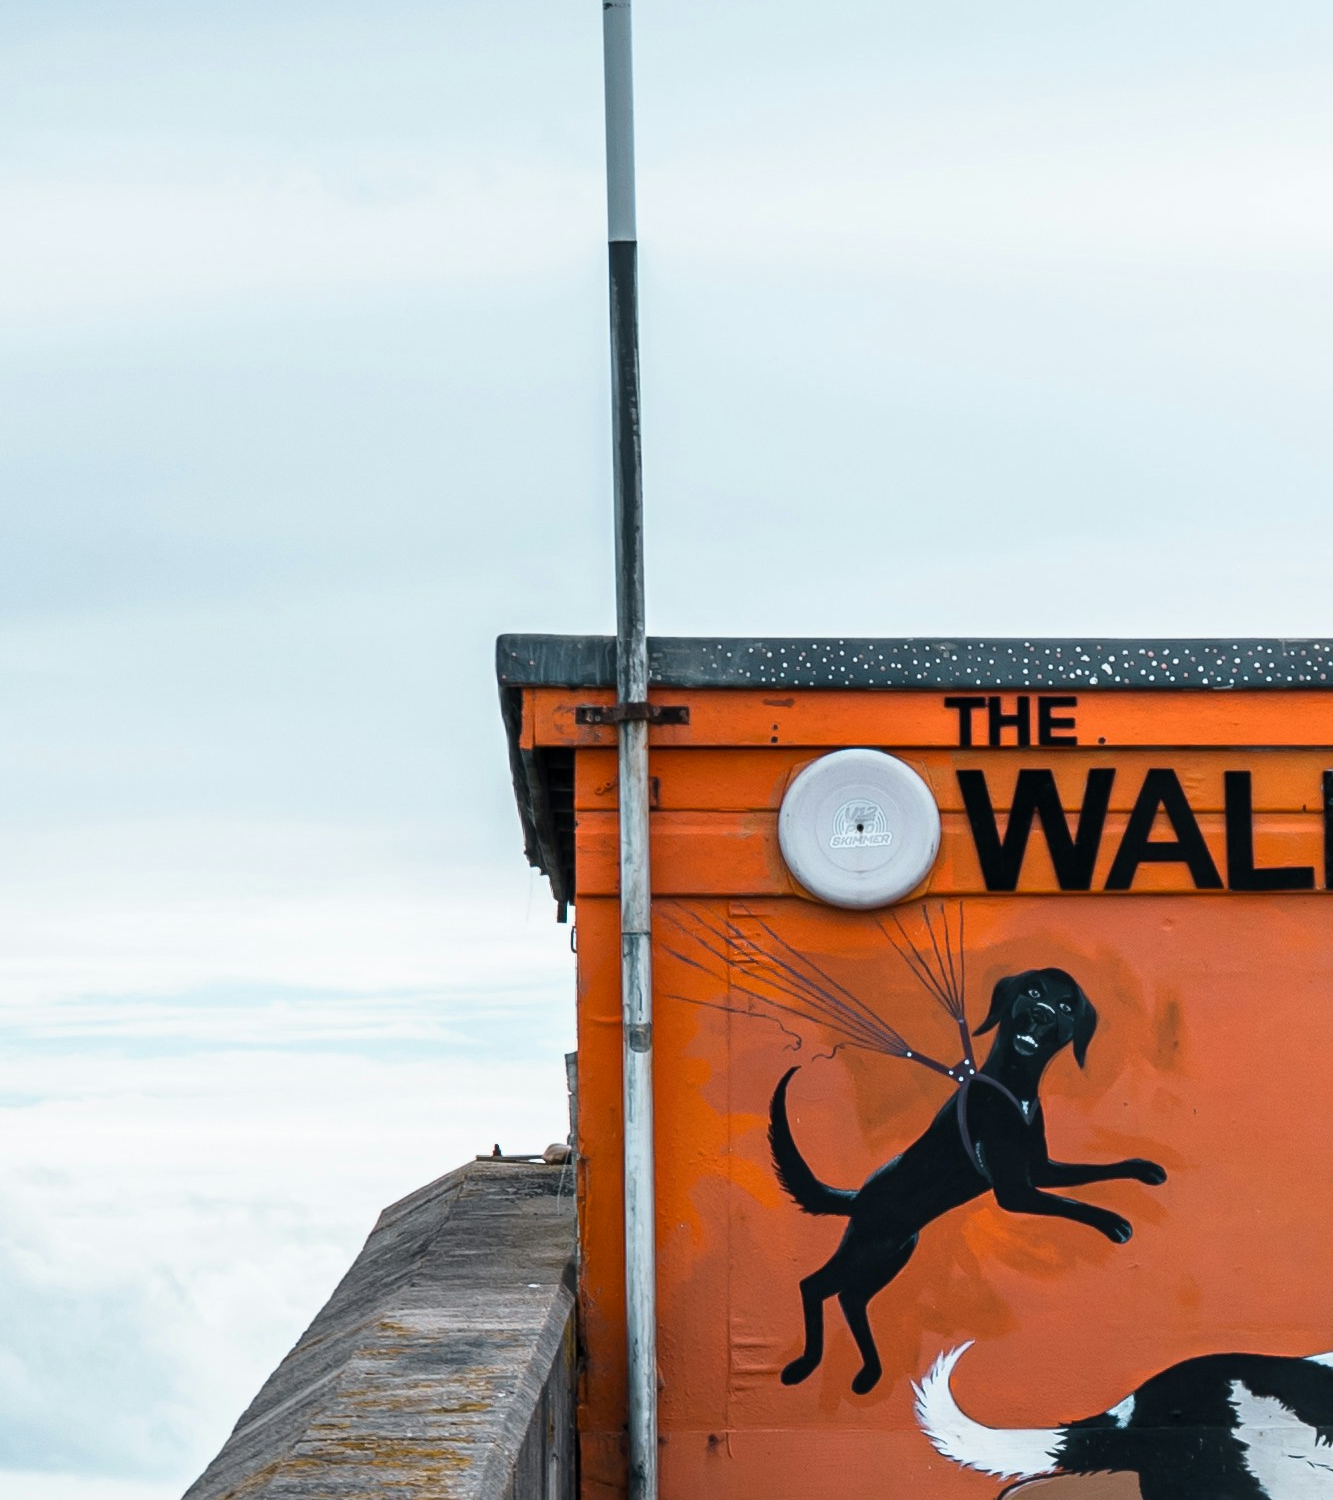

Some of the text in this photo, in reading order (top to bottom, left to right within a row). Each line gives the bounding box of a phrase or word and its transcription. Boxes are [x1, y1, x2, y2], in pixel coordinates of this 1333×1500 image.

[943, 695, 1078, 747] THE
[844, 822, 876, 835] PO
[831, 833, 891, 847] SKIMMER
